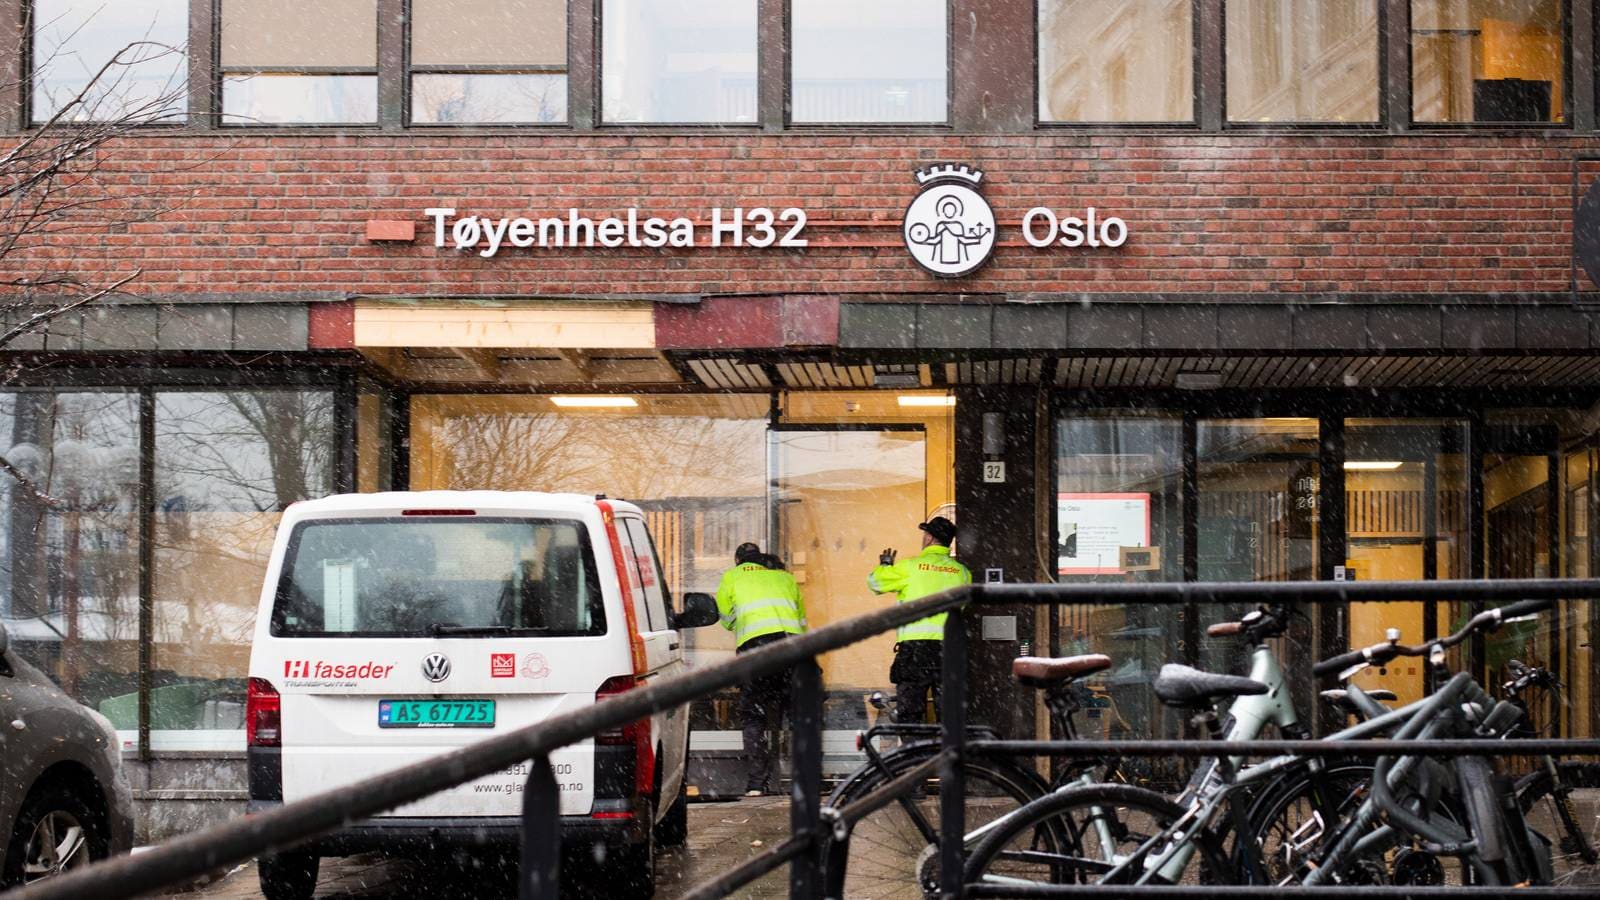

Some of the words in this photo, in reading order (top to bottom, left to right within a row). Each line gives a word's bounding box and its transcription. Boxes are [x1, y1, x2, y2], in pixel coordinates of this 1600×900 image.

[424, 207, 694, 258] Tøyenhelsa
[712, 207, 808, 248] H32
[1022, 206, 1128, 248] Oslo
[986, 465, 1001, 479] 32
[314, 660, 394, 679] fasader
[396, 703, 421, 721] AS
[429, 703, 488, 721] 67725
